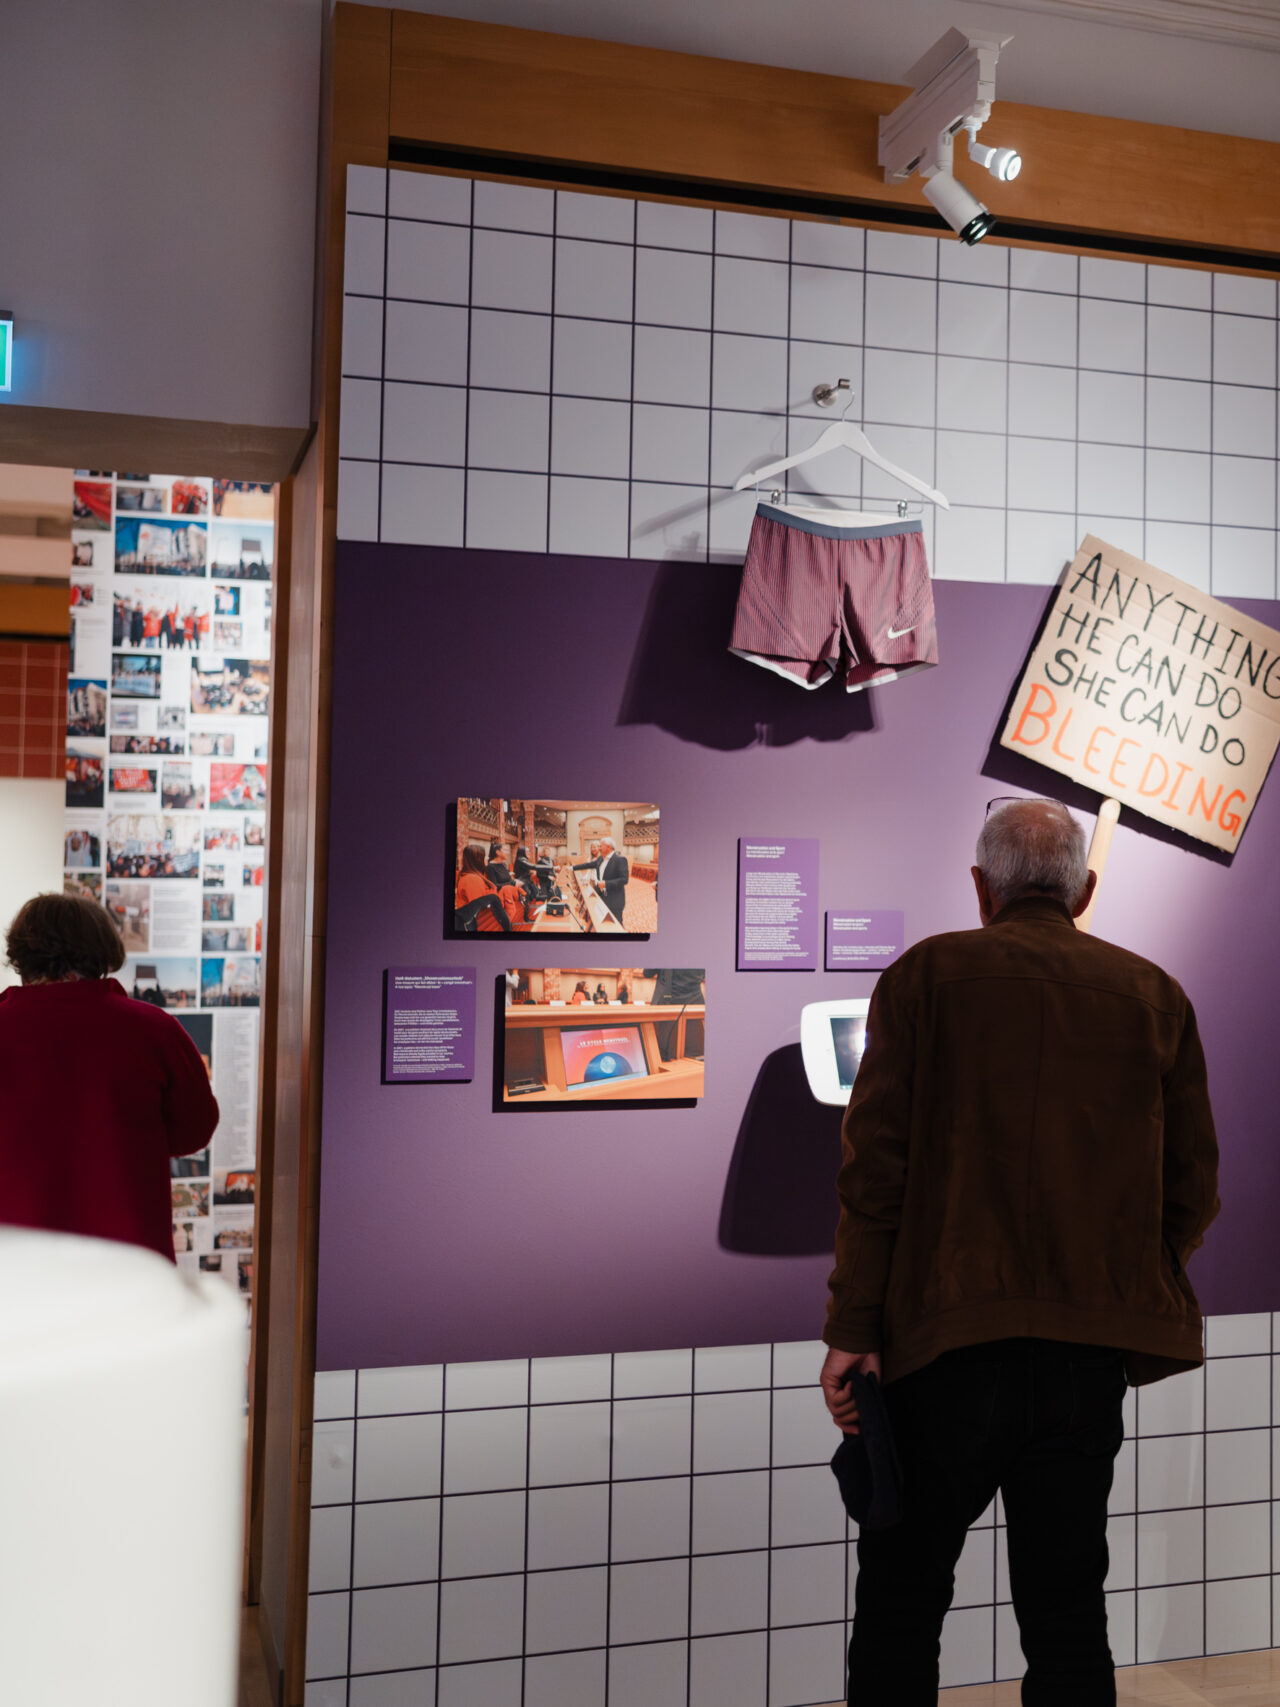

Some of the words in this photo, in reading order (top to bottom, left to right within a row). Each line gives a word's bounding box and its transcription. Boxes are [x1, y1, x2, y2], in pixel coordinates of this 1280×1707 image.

[1044, 648, 1117, 708] SHE
[1119, 687, 1193, 745] CAN
[1199, 724, 1246, 767] DO
[1056, 603, 1115, 655] HE
[1115, 634, 1187, 697] CAN
[1194, 671, 1242, 720] DO
[1010, 682, 1248, 838] BLEEDING
